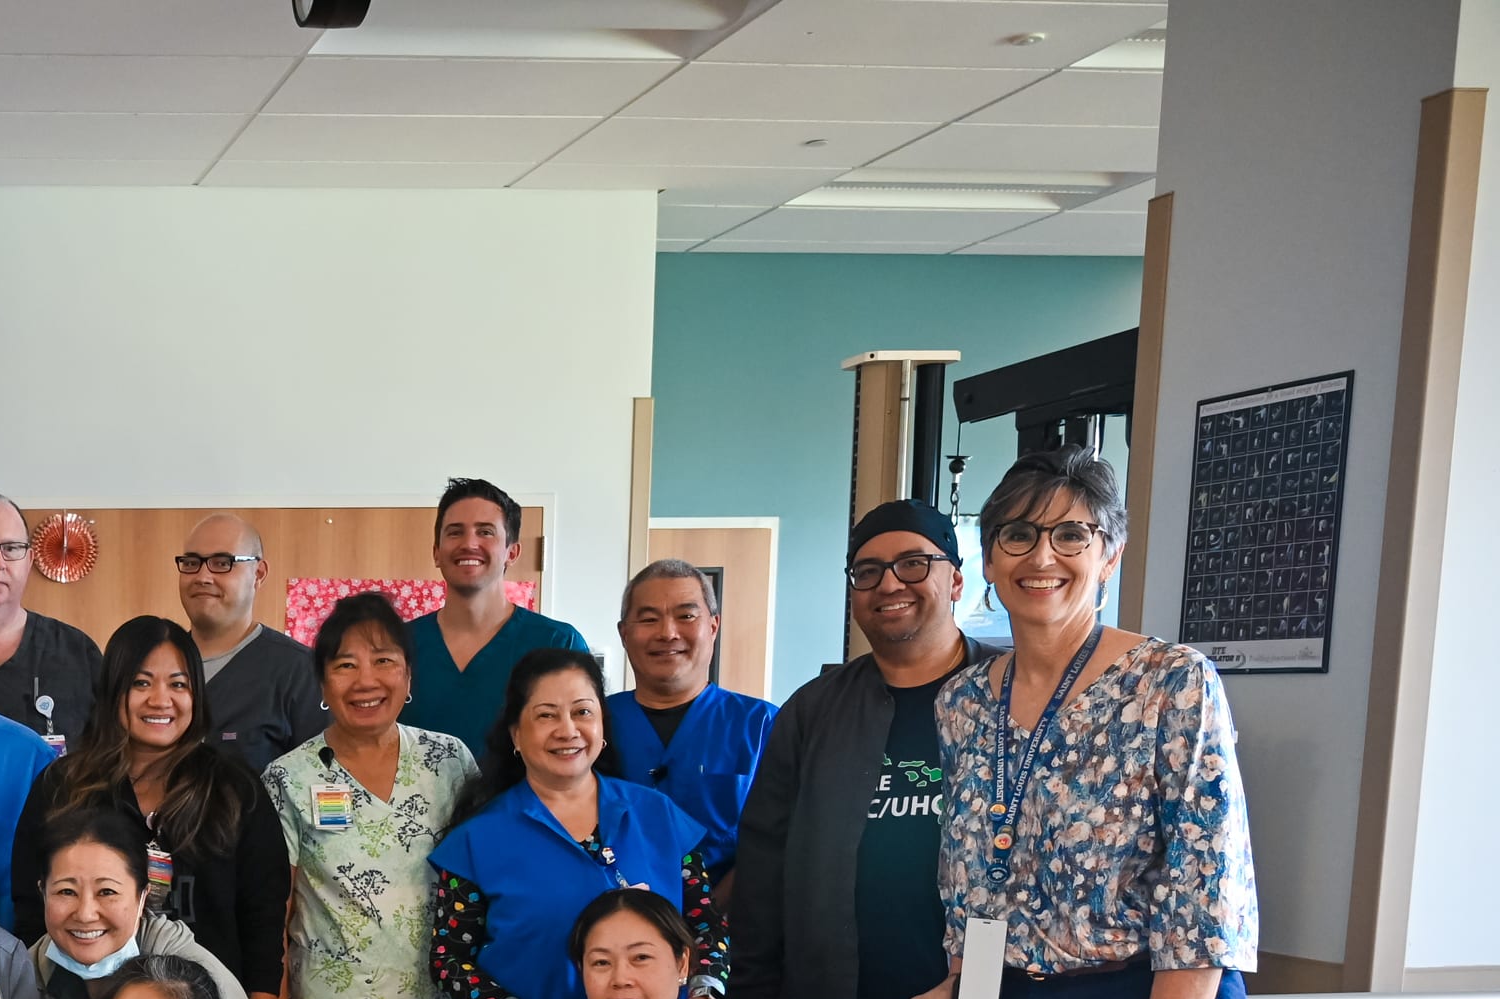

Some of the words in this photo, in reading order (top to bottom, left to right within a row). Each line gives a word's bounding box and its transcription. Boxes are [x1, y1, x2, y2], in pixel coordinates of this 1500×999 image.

[1005, 797, 1020, 825] SAINT
[1015, 768, 1029, 798] LOUIS
[1023, 716, 1050, 771] UNIVERSITY
